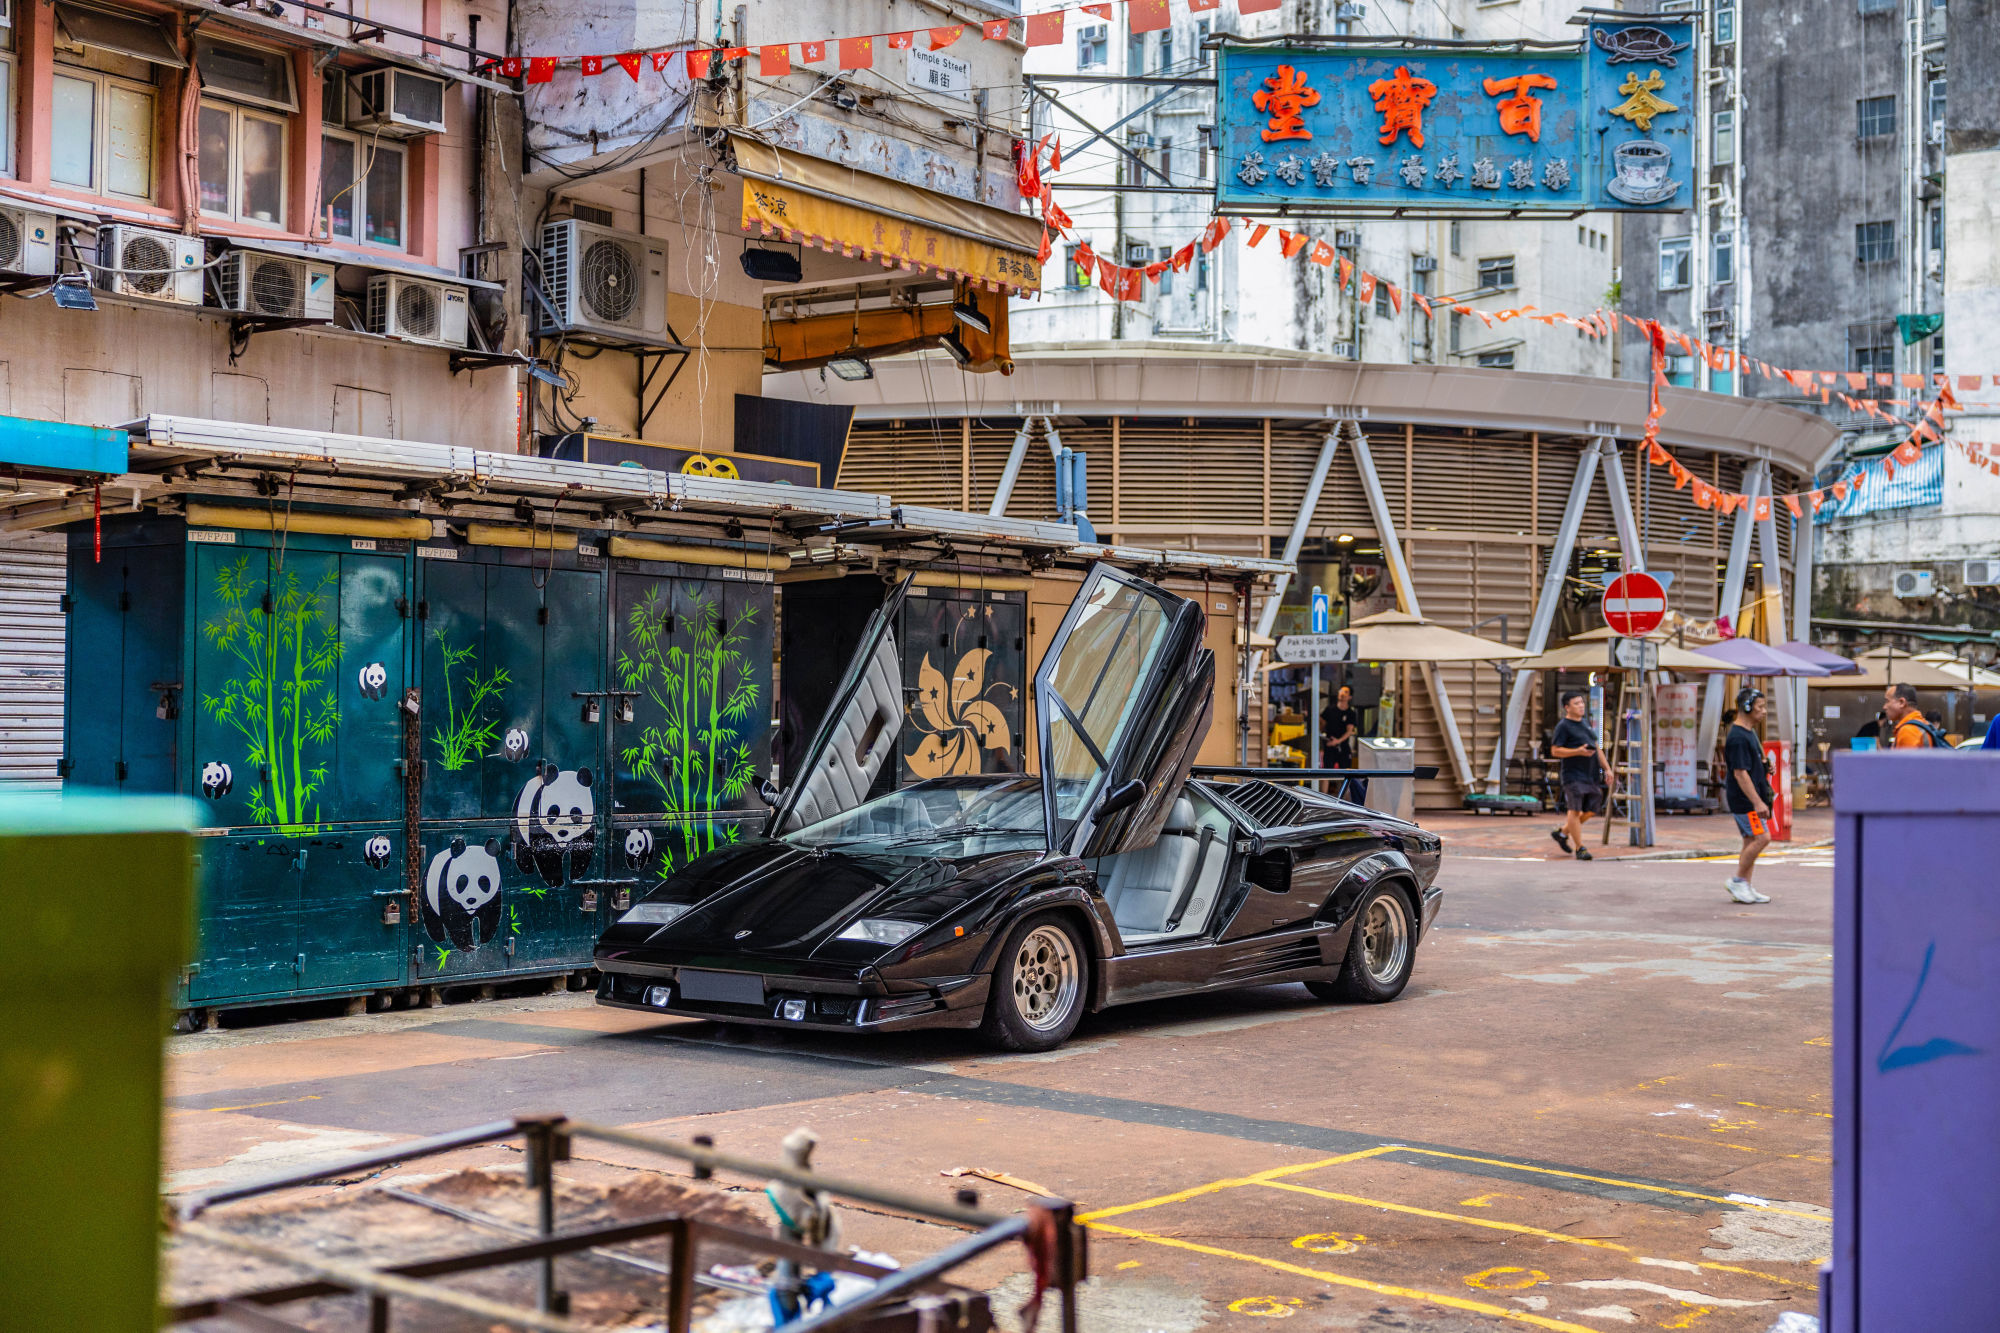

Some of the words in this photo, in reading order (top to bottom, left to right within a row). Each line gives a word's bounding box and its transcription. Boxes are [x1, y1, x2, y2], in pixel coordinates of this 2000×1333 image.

[912, 47, 940, 65] Temple
[942, 58, 967, 75] Street
[928, 69, 950, 88] 廟街
[452, 294, 464, 303] YORK
[188, 531, 234, 542] TE/FP/31
[1287, 638, 1300, 646] Pak
[1316, 637, 1338, 645] Street
[1299, 648, 1327, 658] 北海街
